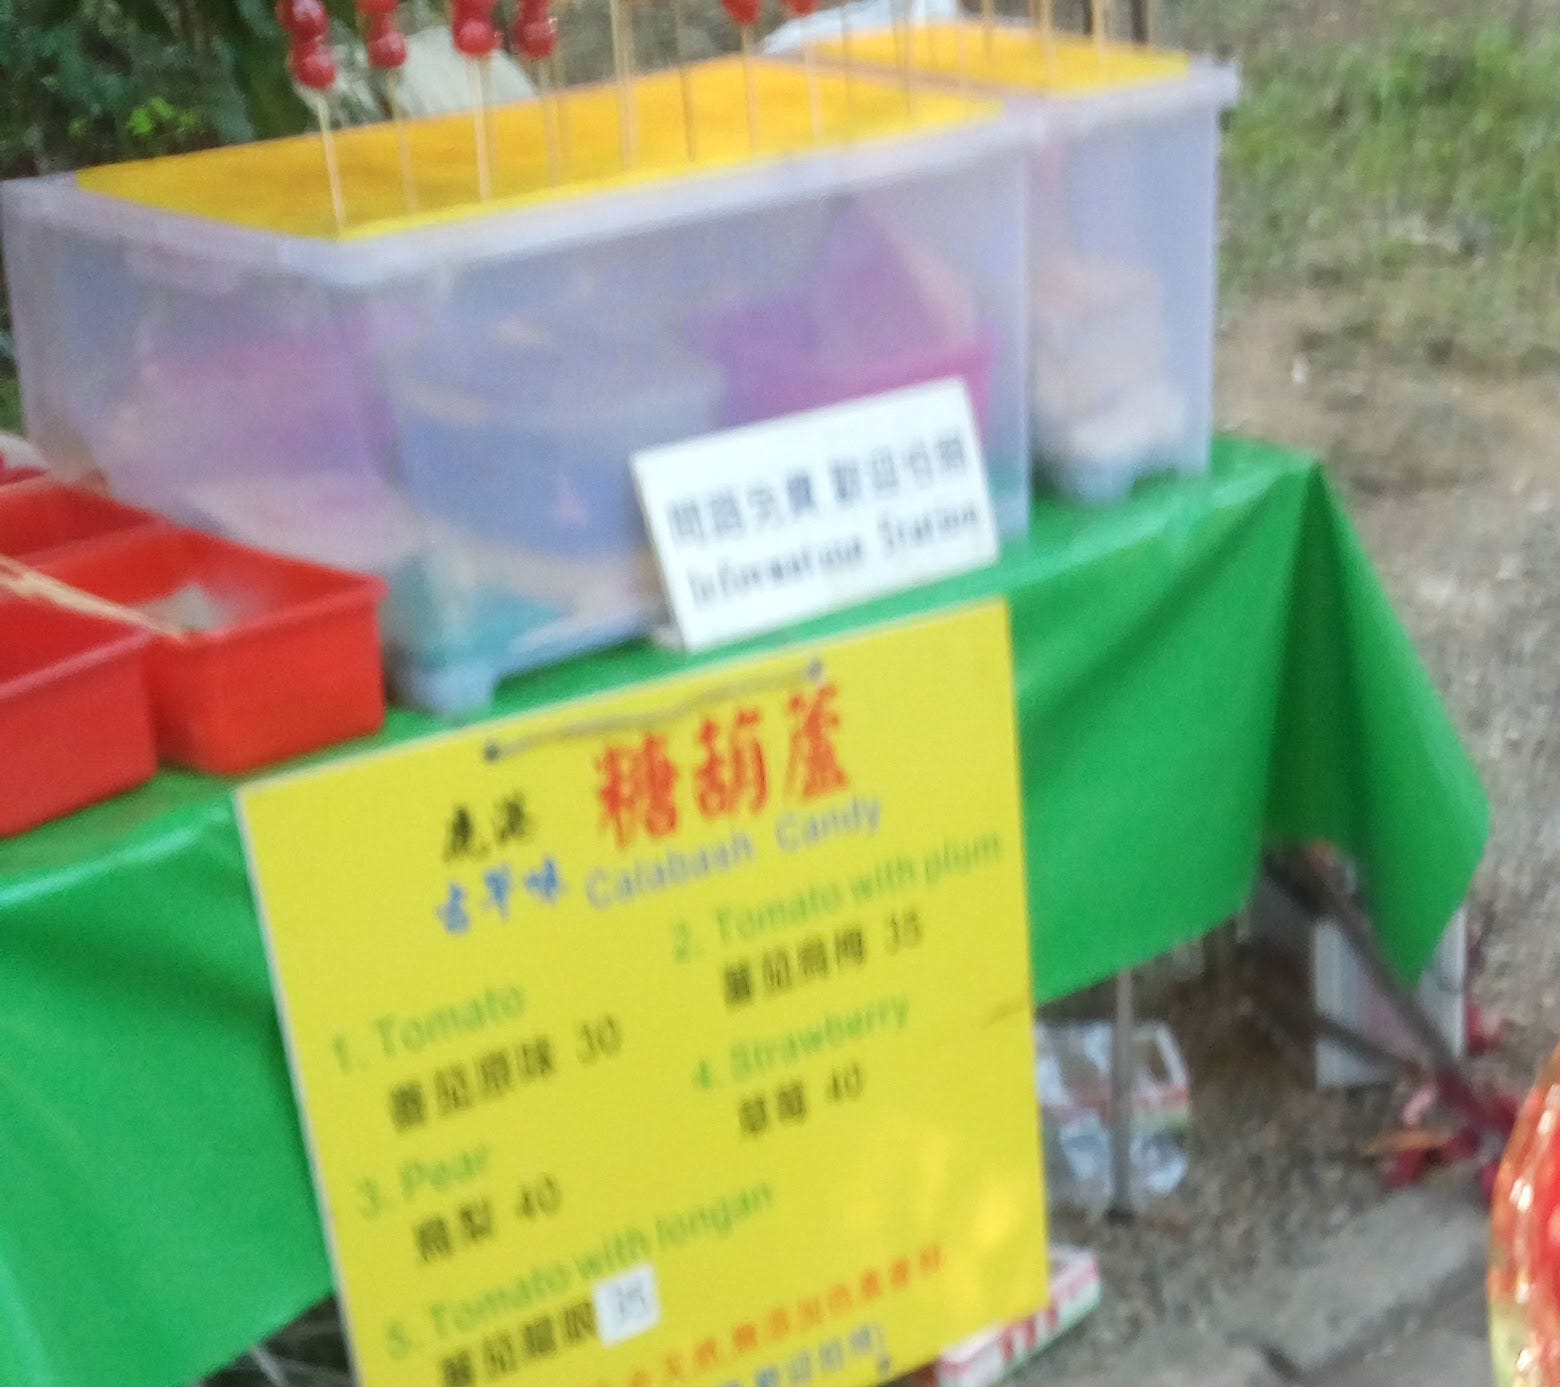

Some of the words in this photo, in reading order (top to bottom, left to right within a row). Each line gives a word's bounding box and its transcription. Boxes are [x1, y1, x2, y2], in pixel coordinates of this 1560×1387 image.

[596, 684, 848, 848] 糖葫蘆
[585, 831, 756, 908] Calabash
[776, 797, 884, 855] Candy
[717, 884, 846, 942] Tomato
[852, 857, 917, 900] with
[924, 832, 1002, 886] plum
[374, 984, 525, 1058] Tomato
[577, 1012, 622, 1065] 30
[730, 997, 909, 1083] Strawberry
[401, 1144, 489, 1200] Pear
[516, 1172, 562, 1220] 40
[428, 1263, 572, 1338] Tomato
[576, 1224, 652, 1281] with
[655, 1181, 775, 1248] longan
